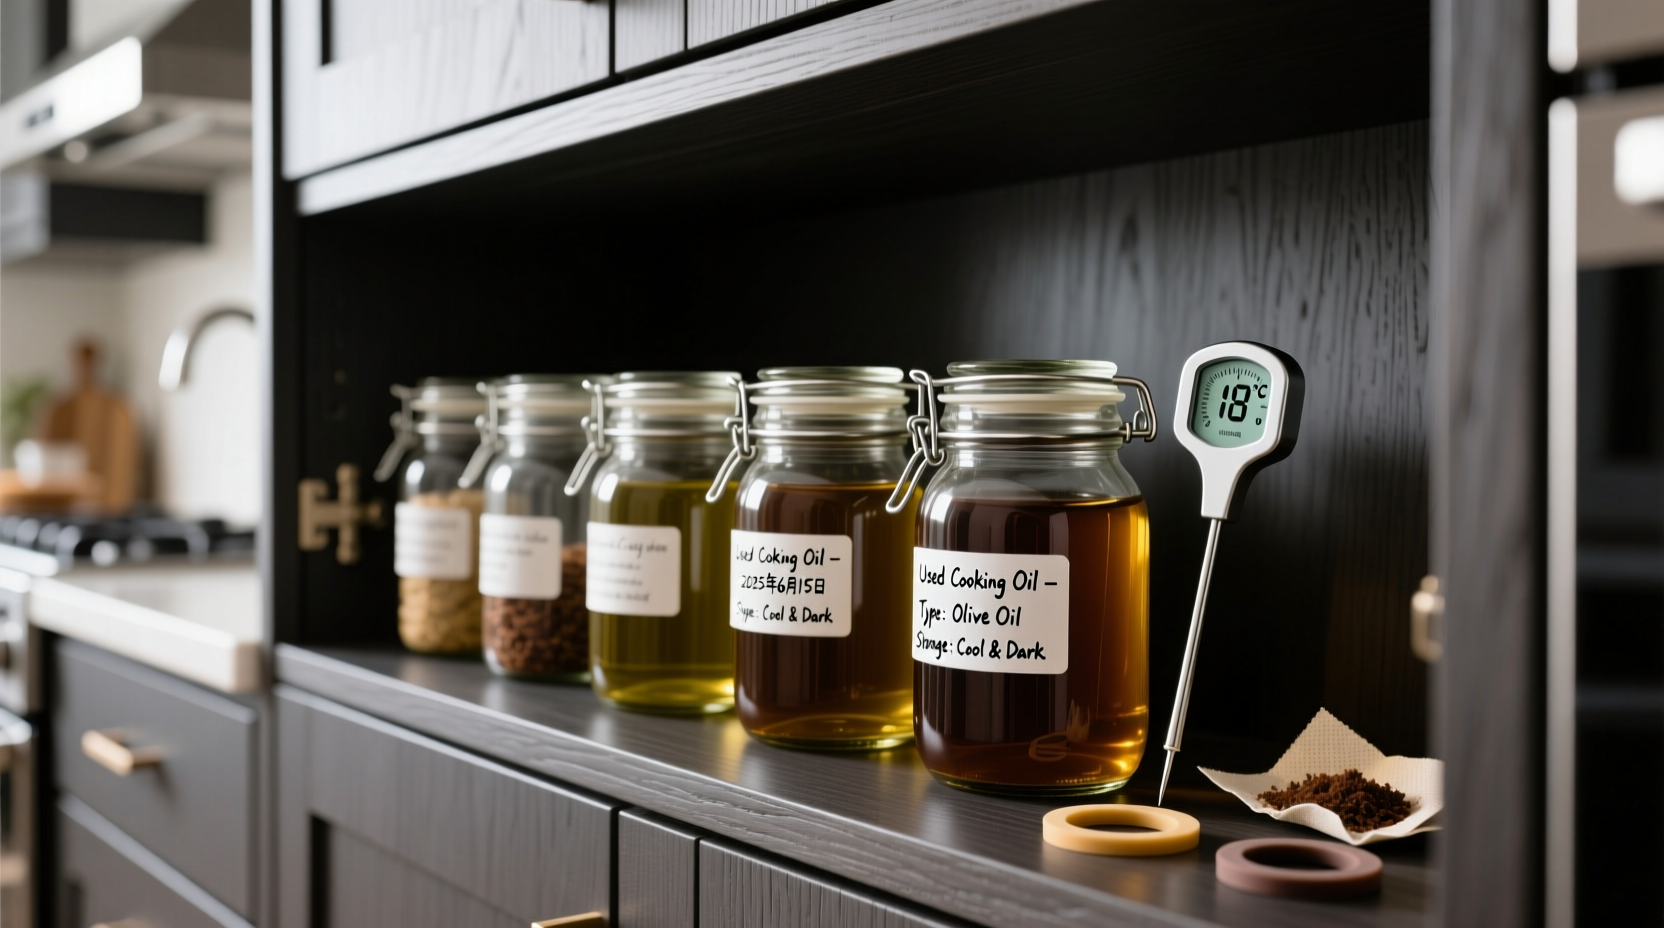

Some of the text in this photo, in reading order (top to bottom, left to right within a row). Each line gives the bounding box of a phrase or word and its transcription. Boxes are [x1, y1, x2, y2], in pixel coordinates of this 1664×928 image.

[803, 547, 825, 566] Oil
[919, 563, 945, 586] Used
[950, 566, 1006, 600] Cooking
[1012, 569, 1039, 592] Oil
[762, 604, 785, 621] Cool
[788, 606, 798, 622] &
[802, 606, 833, 623] Dark
[919, 599, 1022, 629] Type: Olive Oil
[956, 637, 985, 658] Cool
[988, 639, 1002, 660] &
[1006, 640, 1046, 660] Dark
